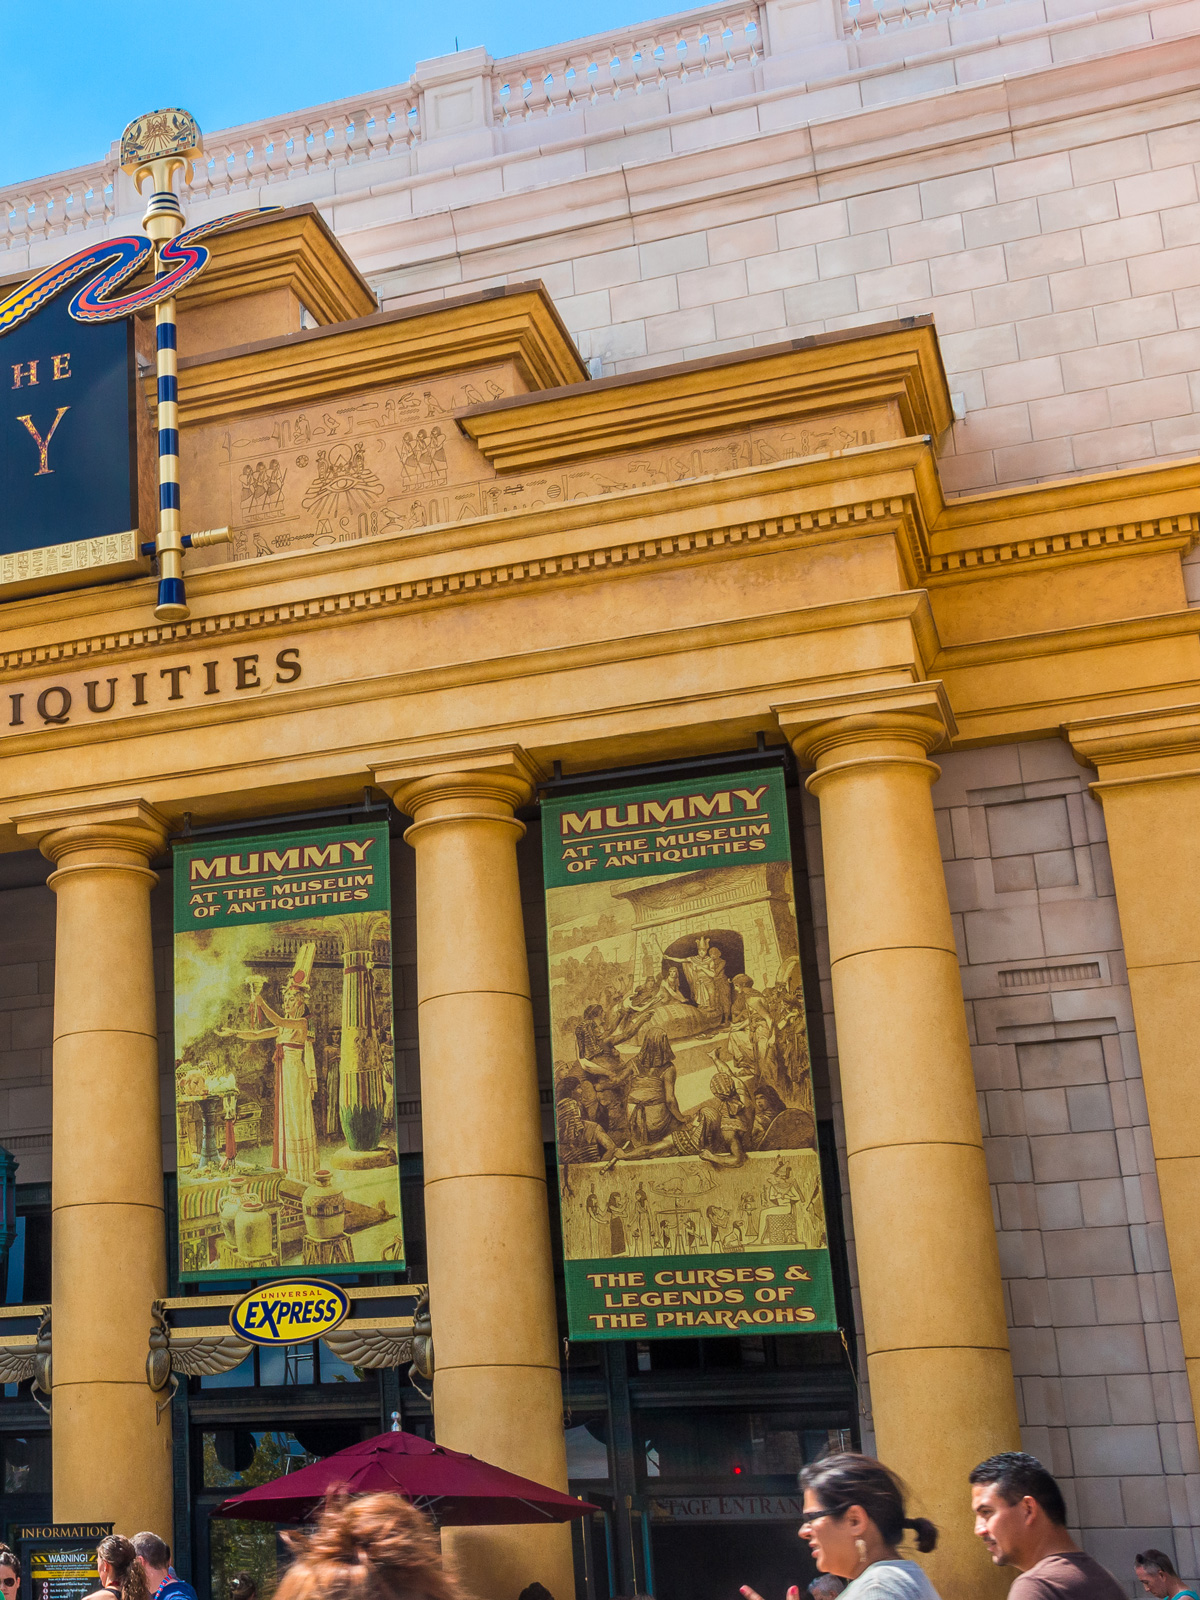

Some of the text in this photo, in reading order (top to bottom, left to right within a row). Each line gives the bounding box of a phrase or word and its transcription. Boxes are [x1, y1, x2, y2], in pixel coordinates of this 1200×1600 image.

[560, 784, 770, 836] MUMMY
[561, 823, 770, 860] AT THE MUSEUM
[190, 837, 376, 882] MUMMY
[567, 839, 766, 873] OF ANTIQUITIES
[189, 874, 374, 905] AT THE MUSEUM
[193, 888, 369, 918] OF ANTIQUITIES
[587, 1265, 812, 1289] THE CURSES &
[261, 1290, 322, 1299] UNIVERSAL
[604, 1286, 795, 1309] LEGENDS OF
[244, 1298, 338, 1337] EXPRESS
[588, 1306, 817, 1330] THE PHARAOHS
[719, 1496, 803, 1515] ENTRAN
[21, 1526, 110, 1539] INFORMATION
[48, 1553, 88, 1563] WARNING!
